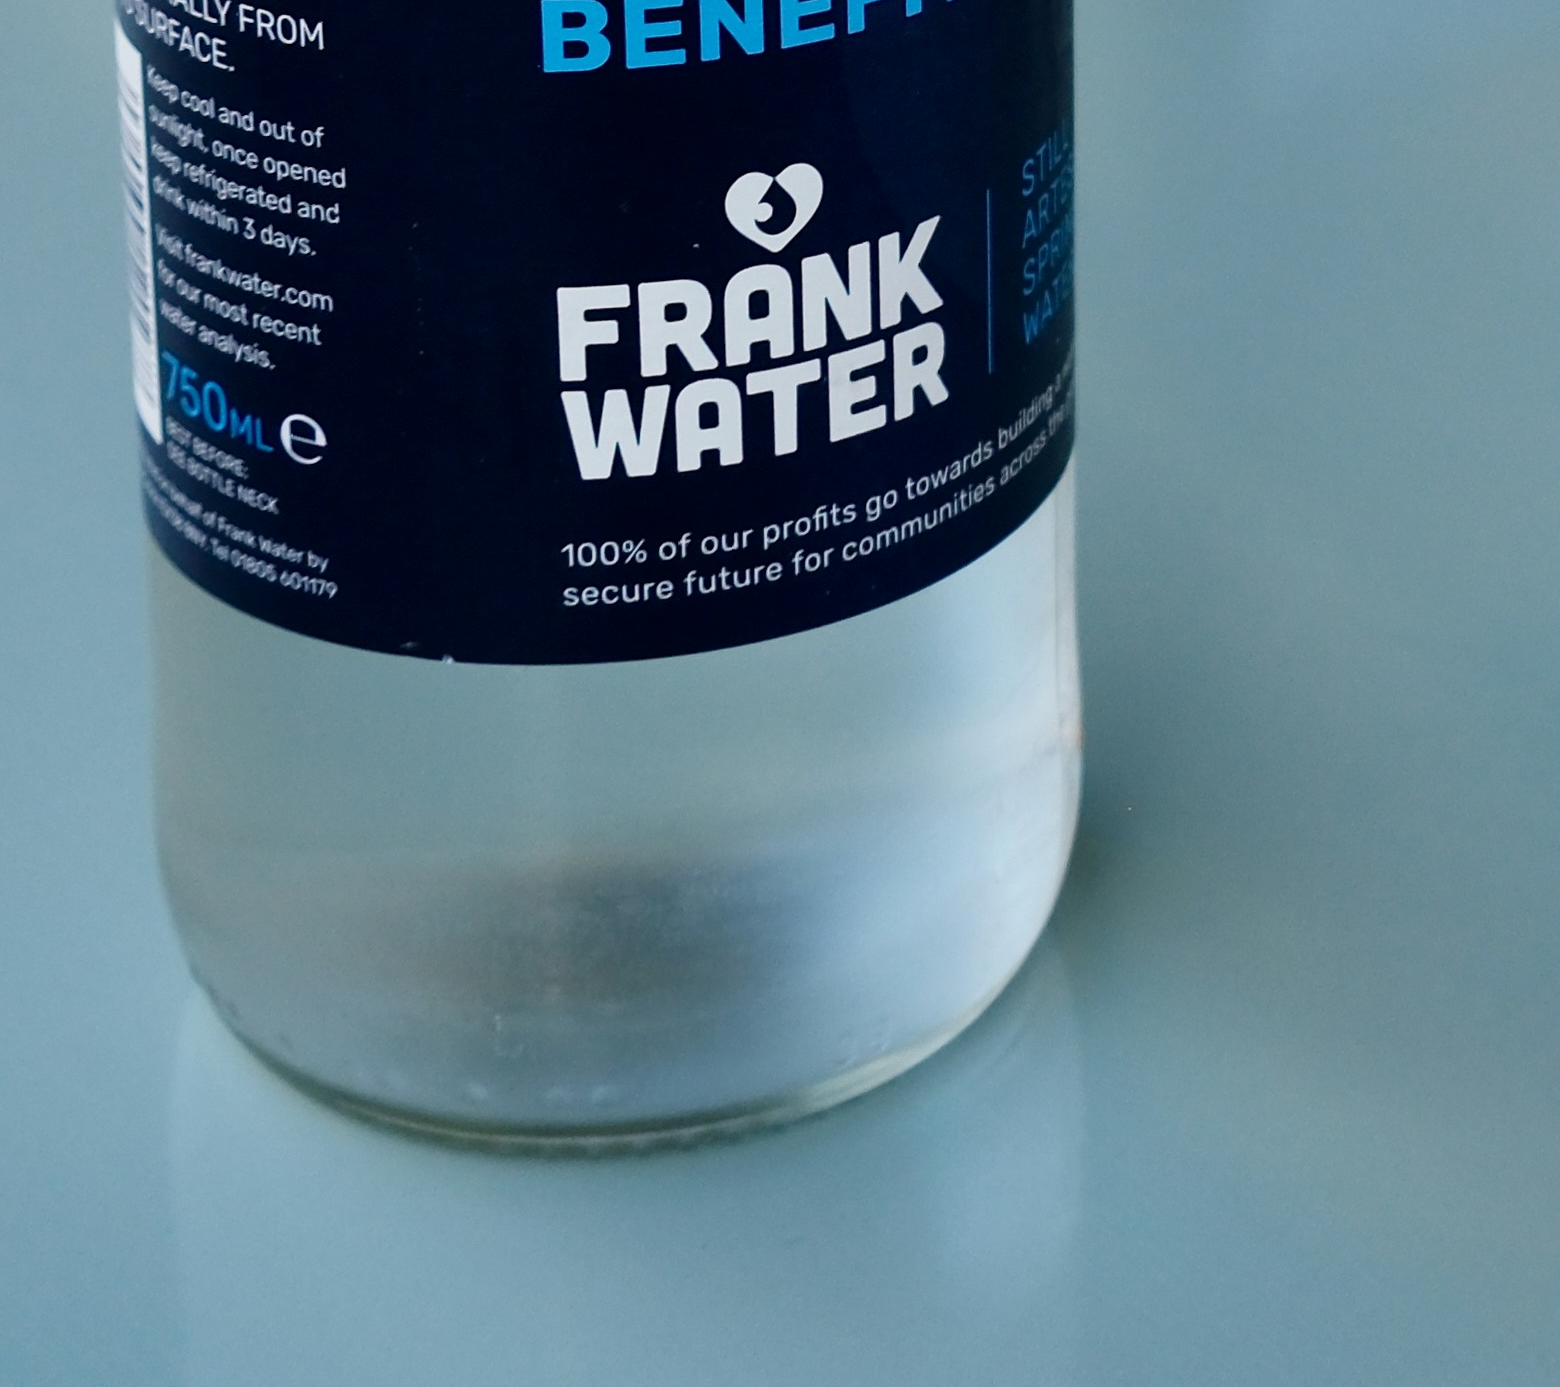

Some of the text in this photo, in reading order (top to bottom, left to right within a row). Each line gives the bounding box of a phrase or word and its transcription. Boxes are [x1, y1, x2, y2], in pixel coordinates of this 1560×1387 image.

[238, 3, 325, 52] FROM
[180, 90, 216, 119] cool
[218, 106, 254, 132] and
[259, 120, 296, 145] out
[300, 126, 325, 148] of
[183, 159, 291, 214] refrigerated
[297, 201, 341, 225] and
[211, 139, 260, 170] once
[262, 156, 347, 189] opened
[186, 197, 240, 235] within
[243, 216, 257, 240] 3
[260, 223, 318, 257] days.
[184, 242, 335, 313] frankwater.com
[556, 214, 945, 383] FRANK
[197, 325, 277, 371] analysis.
[203, 292, 250, 327] most
[252, 312, 323, 346] recent
[560, 321, 951, 482] WATER
[237, 484, 281, 515] NECK
[560, 538, 648, 569] 100%
[658, 532, 693, 562] of
[700, 526, 754, 556] our
[762, 502, 857, 550] profits
[865, 490, 898, 524] go
[905, 441, 994, 500] towards
[997, 384, 1054, 450] building
[562, 574, 674, 607] secure
[684, 557, 784, 596] future
[792, 543, 835, 575] for
[842, 475, 996, 563] communities
[998, 428, 1047, 486] across
[257, 533, 305, 564] Water
[306, 549, 331, 574] by
[279, 569, 340, 601] 601179
